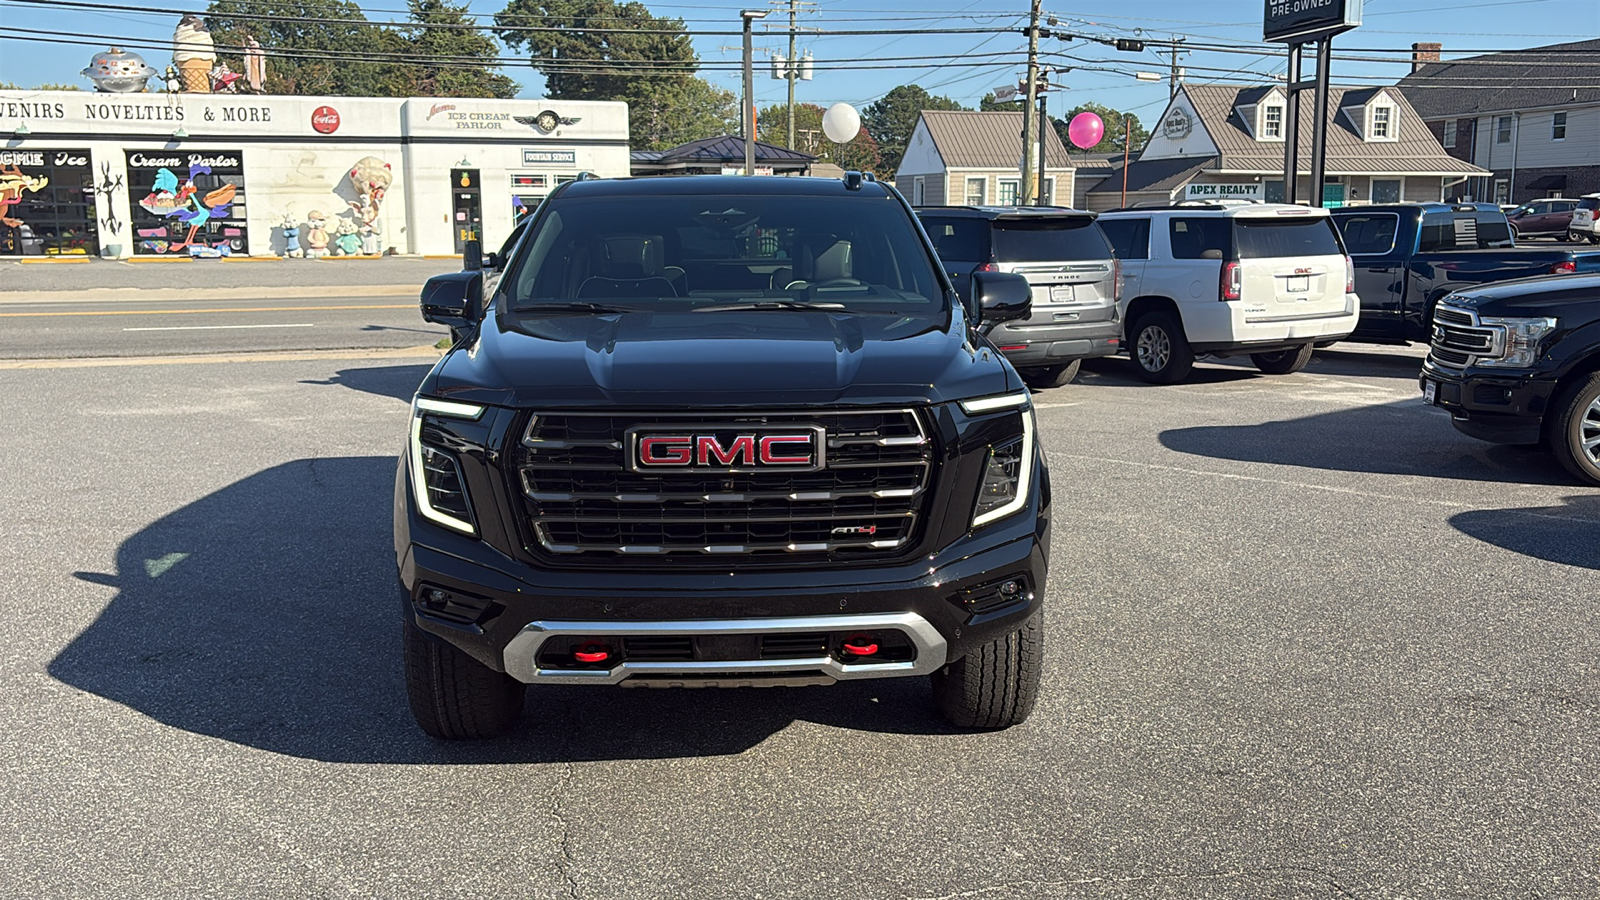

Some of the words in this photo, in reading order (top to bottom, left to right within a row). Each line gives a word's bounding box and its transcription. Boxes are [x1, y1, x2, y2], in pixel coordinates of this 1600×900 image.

[85, 104, 185, 120] NOVELTIES
[204, 107, 215, 121] &
[222, 107, 271, 121] MORE
[447, 112, 467, 121] ICE
[469, 113, 510, 121] CREAM
[456, 121, 502, 129] PARLOR
[0, 151, 44, 166] CME
[54, 152, 88, 166] Ice
[129, 153, 182, 167] Cream
[187, 153, 239, 168] Parlor
[552, 153, 574, 161] SERVICE
[1190, 185, 1217, 195] APEX
[1219, 185, 1259, 194] REALTY
[640, 432, 813, 467] GMC
[831, 524, 876, 535] AT4
